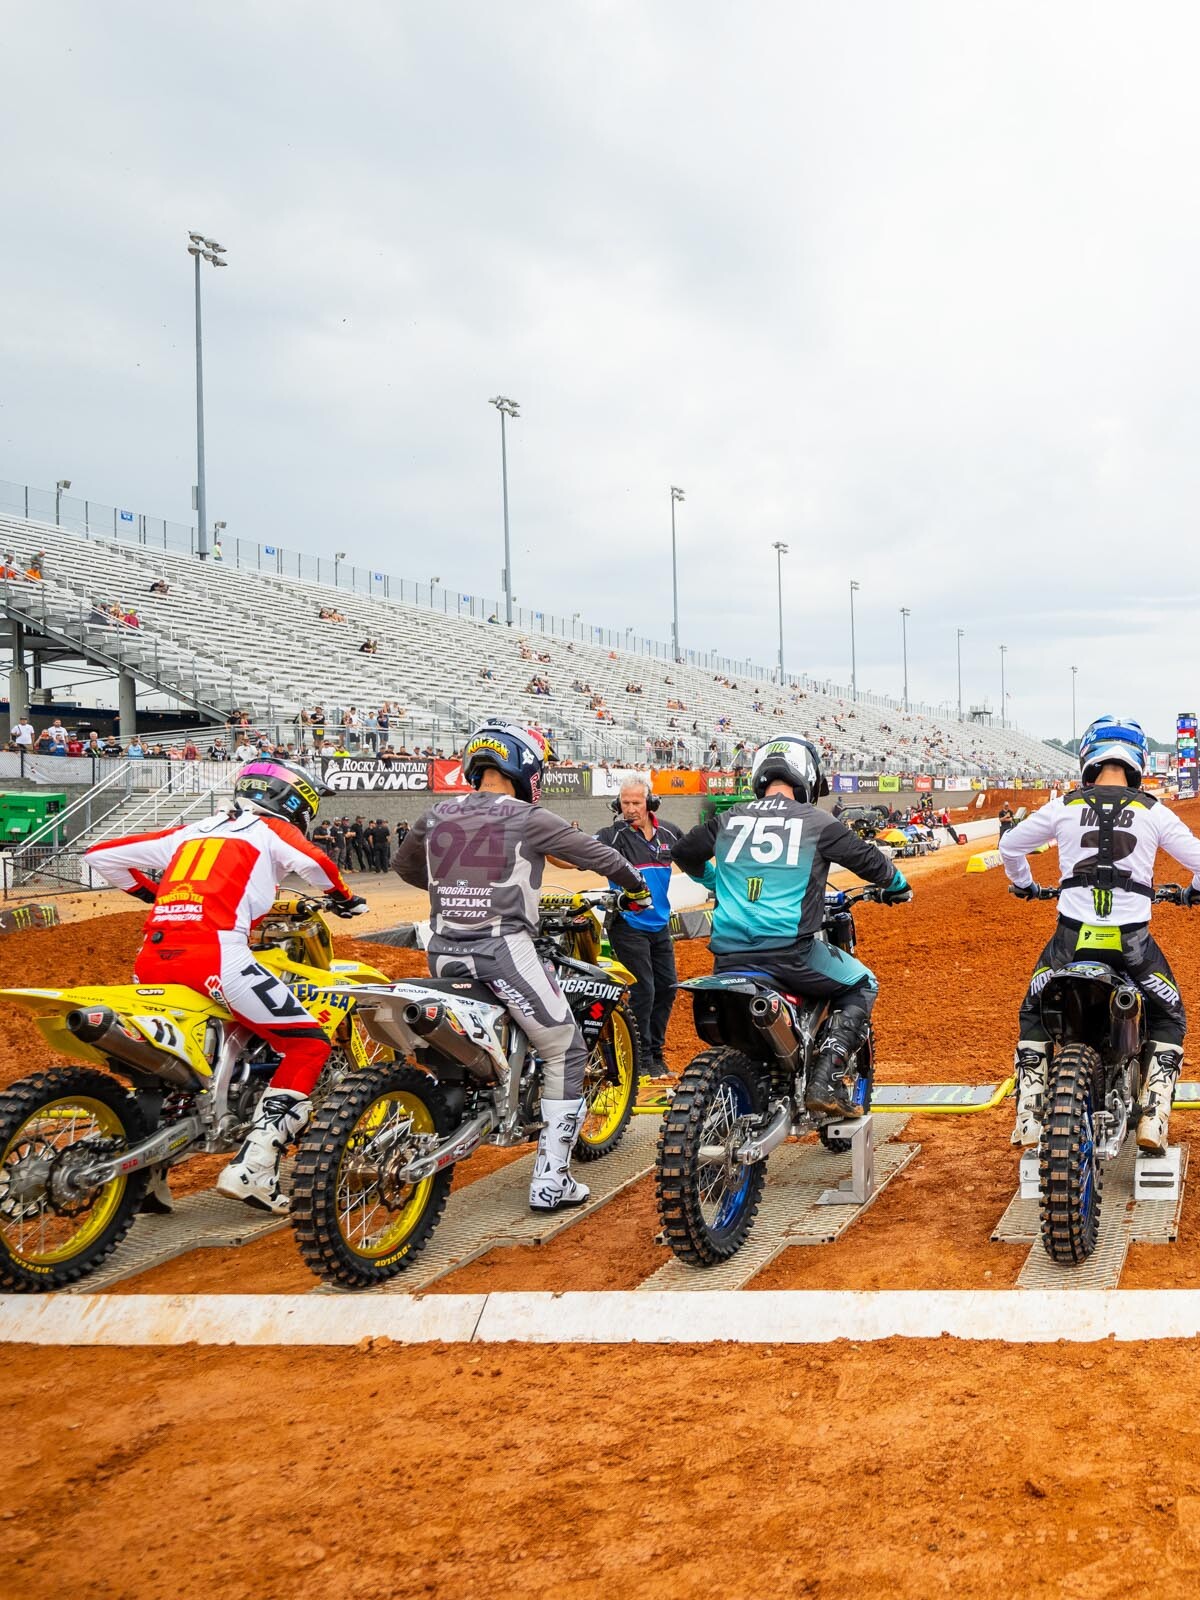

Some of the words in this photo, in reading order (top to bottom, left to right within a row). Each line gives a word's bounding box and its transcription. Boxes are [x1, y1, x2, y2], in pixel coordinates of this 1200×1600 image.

[342, 758, 375, 772] ROCKY
[747, 799, 787, 810] HILL
[724, 815, 804, 866] 751
[431, 821, 508, 881] 94
[169, 839, 226, 882] 11
[437, 886, 493, 896] PROGRESSIVE
[154, 904, 203, 915] SUZUKI
[440, 898, 491, 908] SUZUKI
[441, 910, 487, 919] ECSTAR
[1141, 973, 1180, 1006] THOR
[494, 978, 535, 1017] SUZUKI
